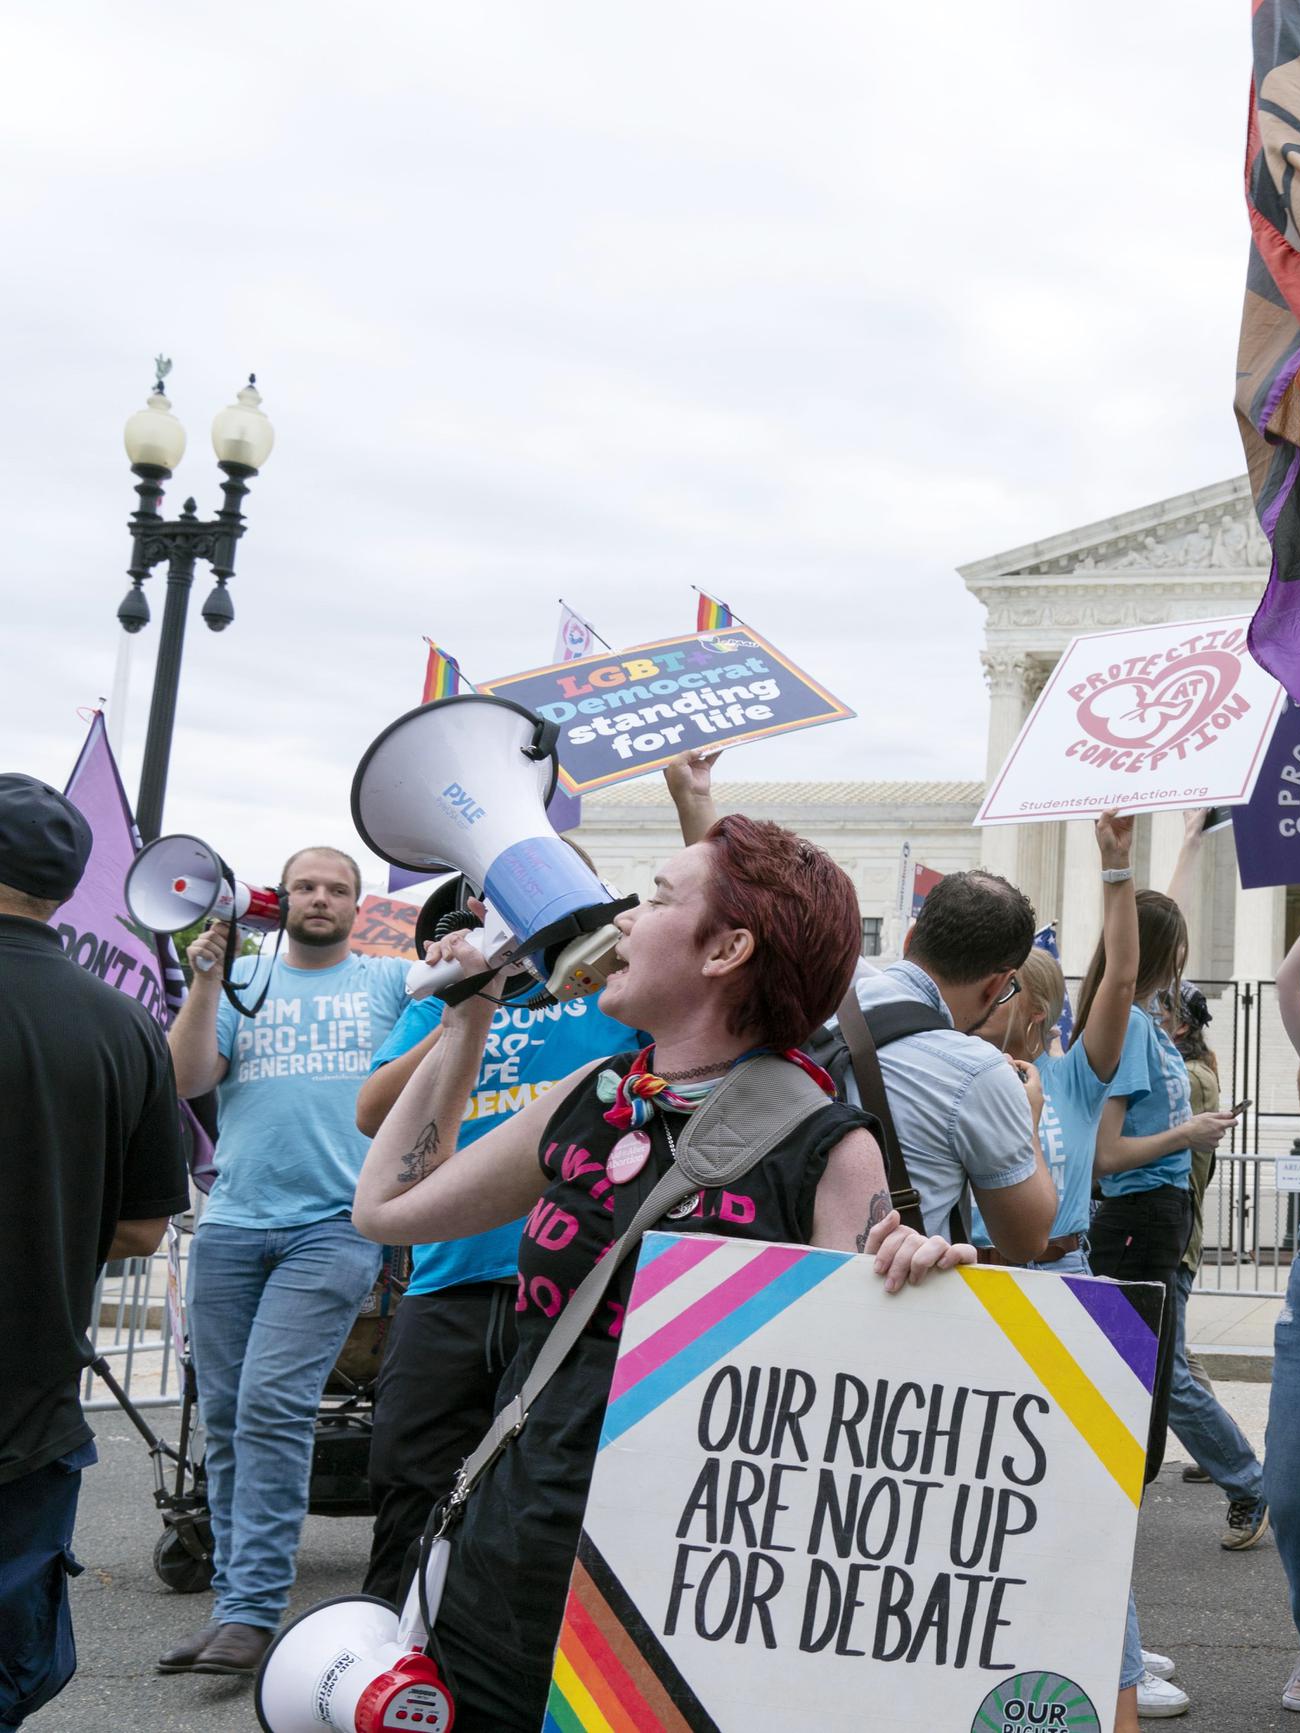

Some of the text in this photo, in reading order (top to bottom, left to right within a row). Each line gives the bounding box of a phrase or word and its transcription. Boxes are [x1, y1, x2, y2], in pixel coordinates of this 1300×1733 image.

[535, 656, 770, 724] Democrat
[1171, 679, 1204, 701] AT
[568, 678, 782, 745] standing
[611, 722, 686, 760] for
[690, 702, 775, 734] life
[1065, 692, 1251, 774] CONCEPTION
[1019, 786, 1208, 811] StudentsforLifeAction.org
[313, 991, 370, 1021] THE
[490, 997, 587, 1030] OUNG
[238, 1020, 373, 1060] PRO-LIFE
[482, 1033, 545, 1057] RO-
[238, 1051, 372, 1083] GENERATION
[698, 1365, 1050, 1486] OUR RIGHTS
[676, 1457, 1038, 1573] ARE NOT UP
[663, 1543, 1027, 1670] FOR DEBATE
[1004, 1699, 1067, 1727] OUR
